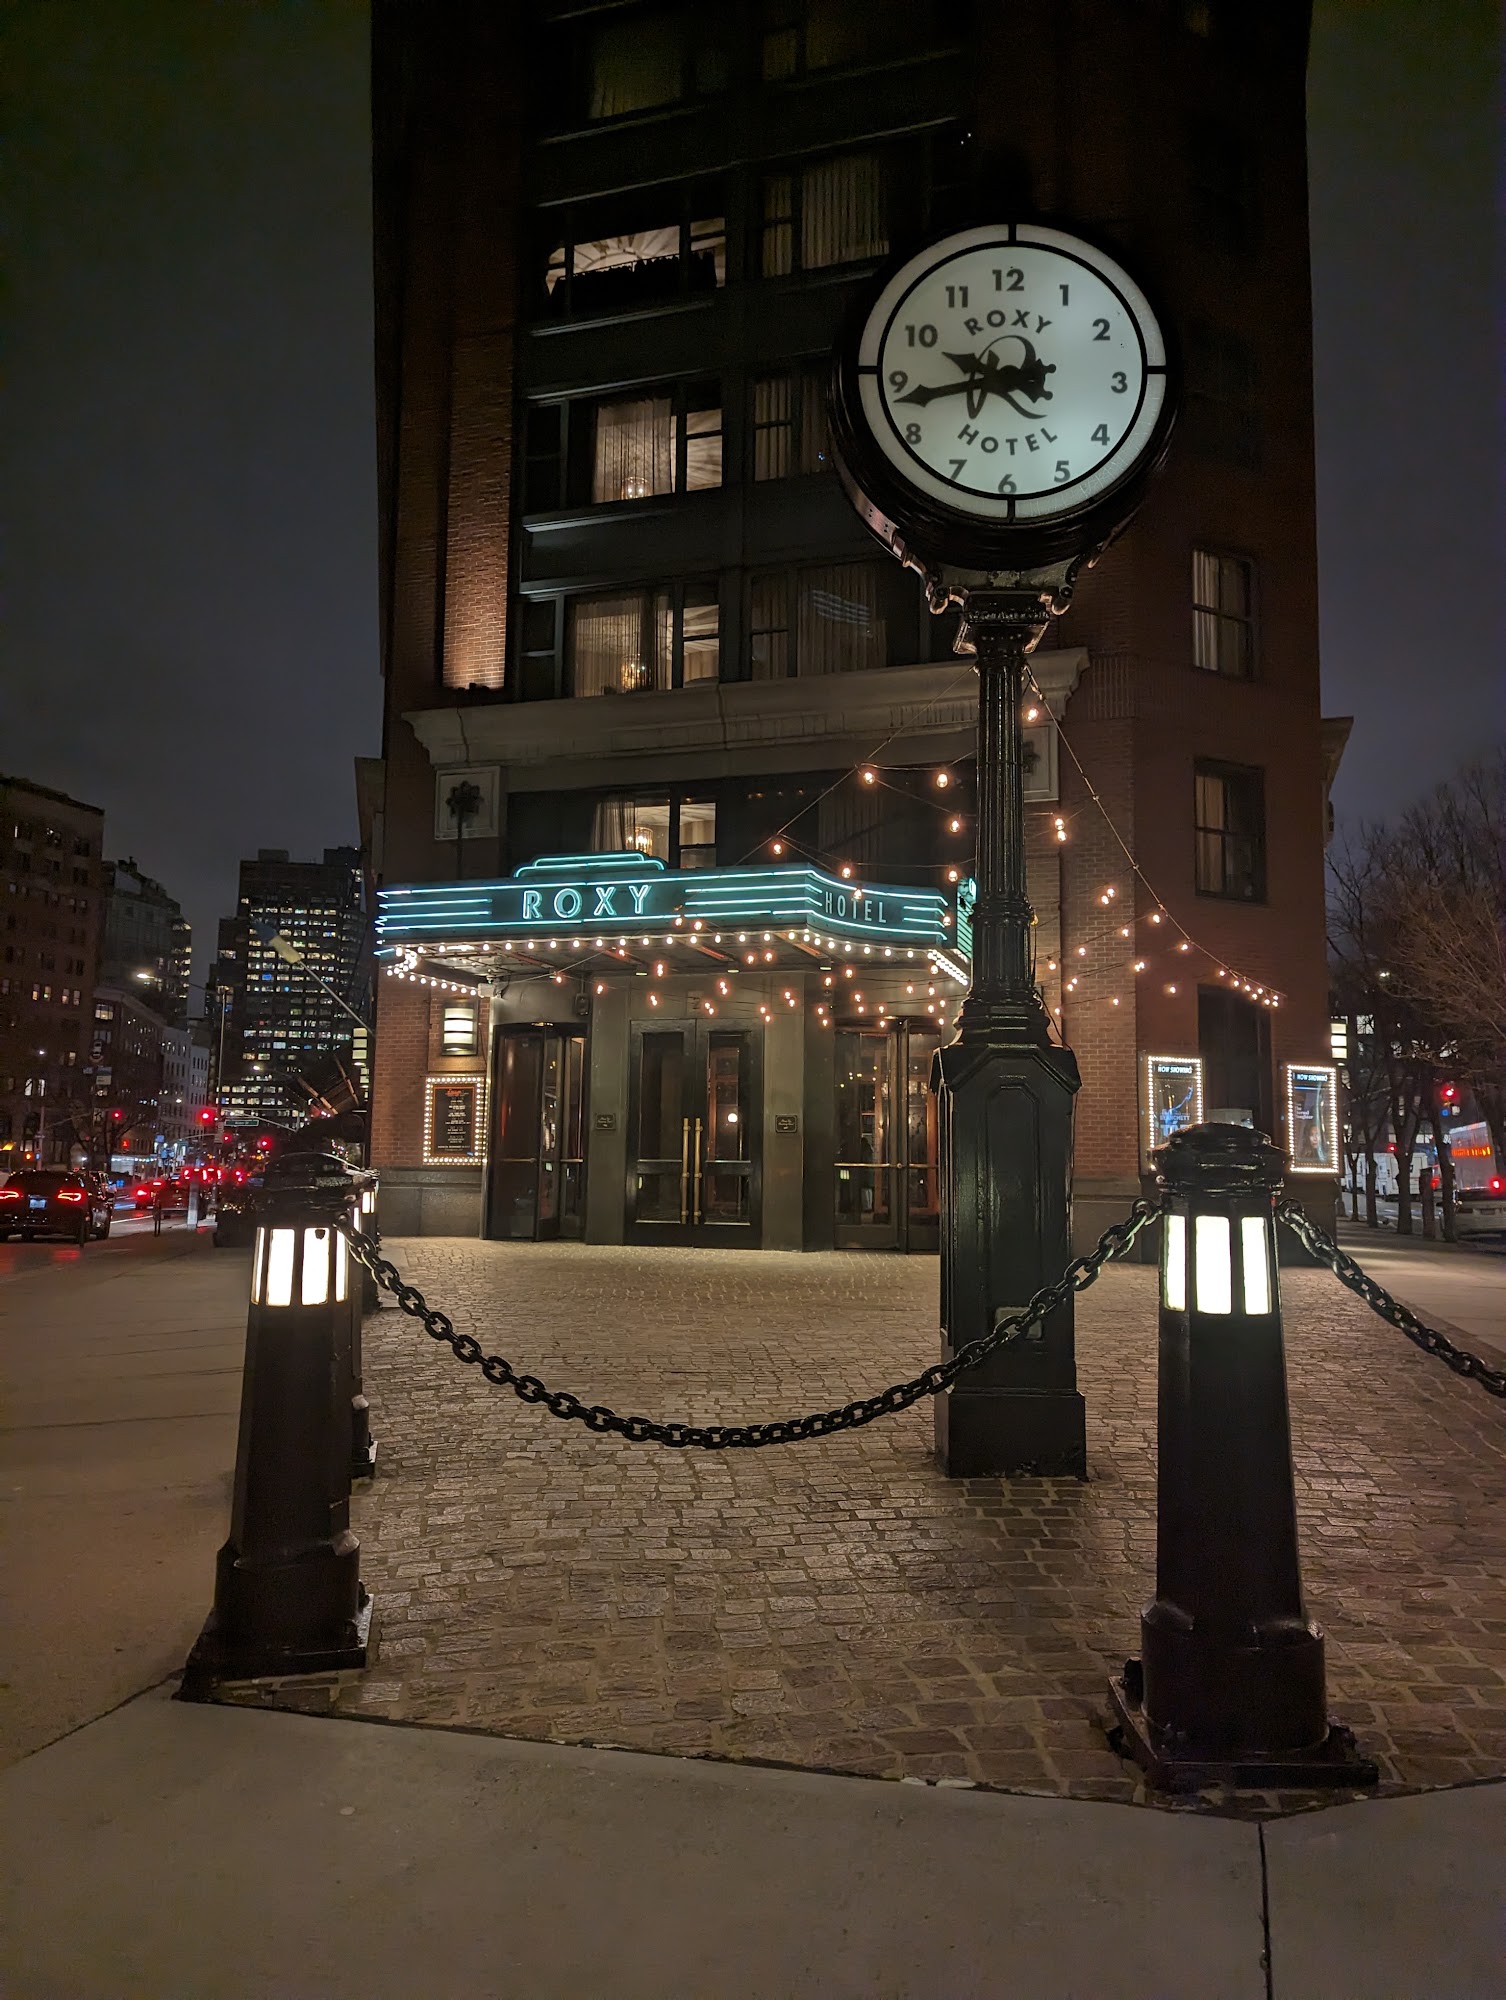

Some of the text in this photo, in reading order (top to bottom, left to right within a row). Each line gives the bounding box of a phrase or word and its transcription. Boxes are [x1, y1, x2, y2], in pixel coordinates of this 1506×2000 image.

[992, 269, 1025, 292] 12
[945, 286, 969, 308] 11
[1059, 284, 1070, 306] 1
[964, 309, 1052, 336] ROXY
[1092, 318, 1111, 342] 2
[905, 324, 938, 348] 10
[889, 370, 909, 393] 9
[1111, 372, 1128, 394] 3
[905, 423, 923, 445] 8
[957, 424, 1058, 456] HOTEL
[1090, 423, 1111, 446] 4
[949, 459, 968, 481] 7
[1053, 460, 1071, 483] 5
[998, 474, 1017, 494] 6
[523, 884, 887, 924] ROXY HOTEL
